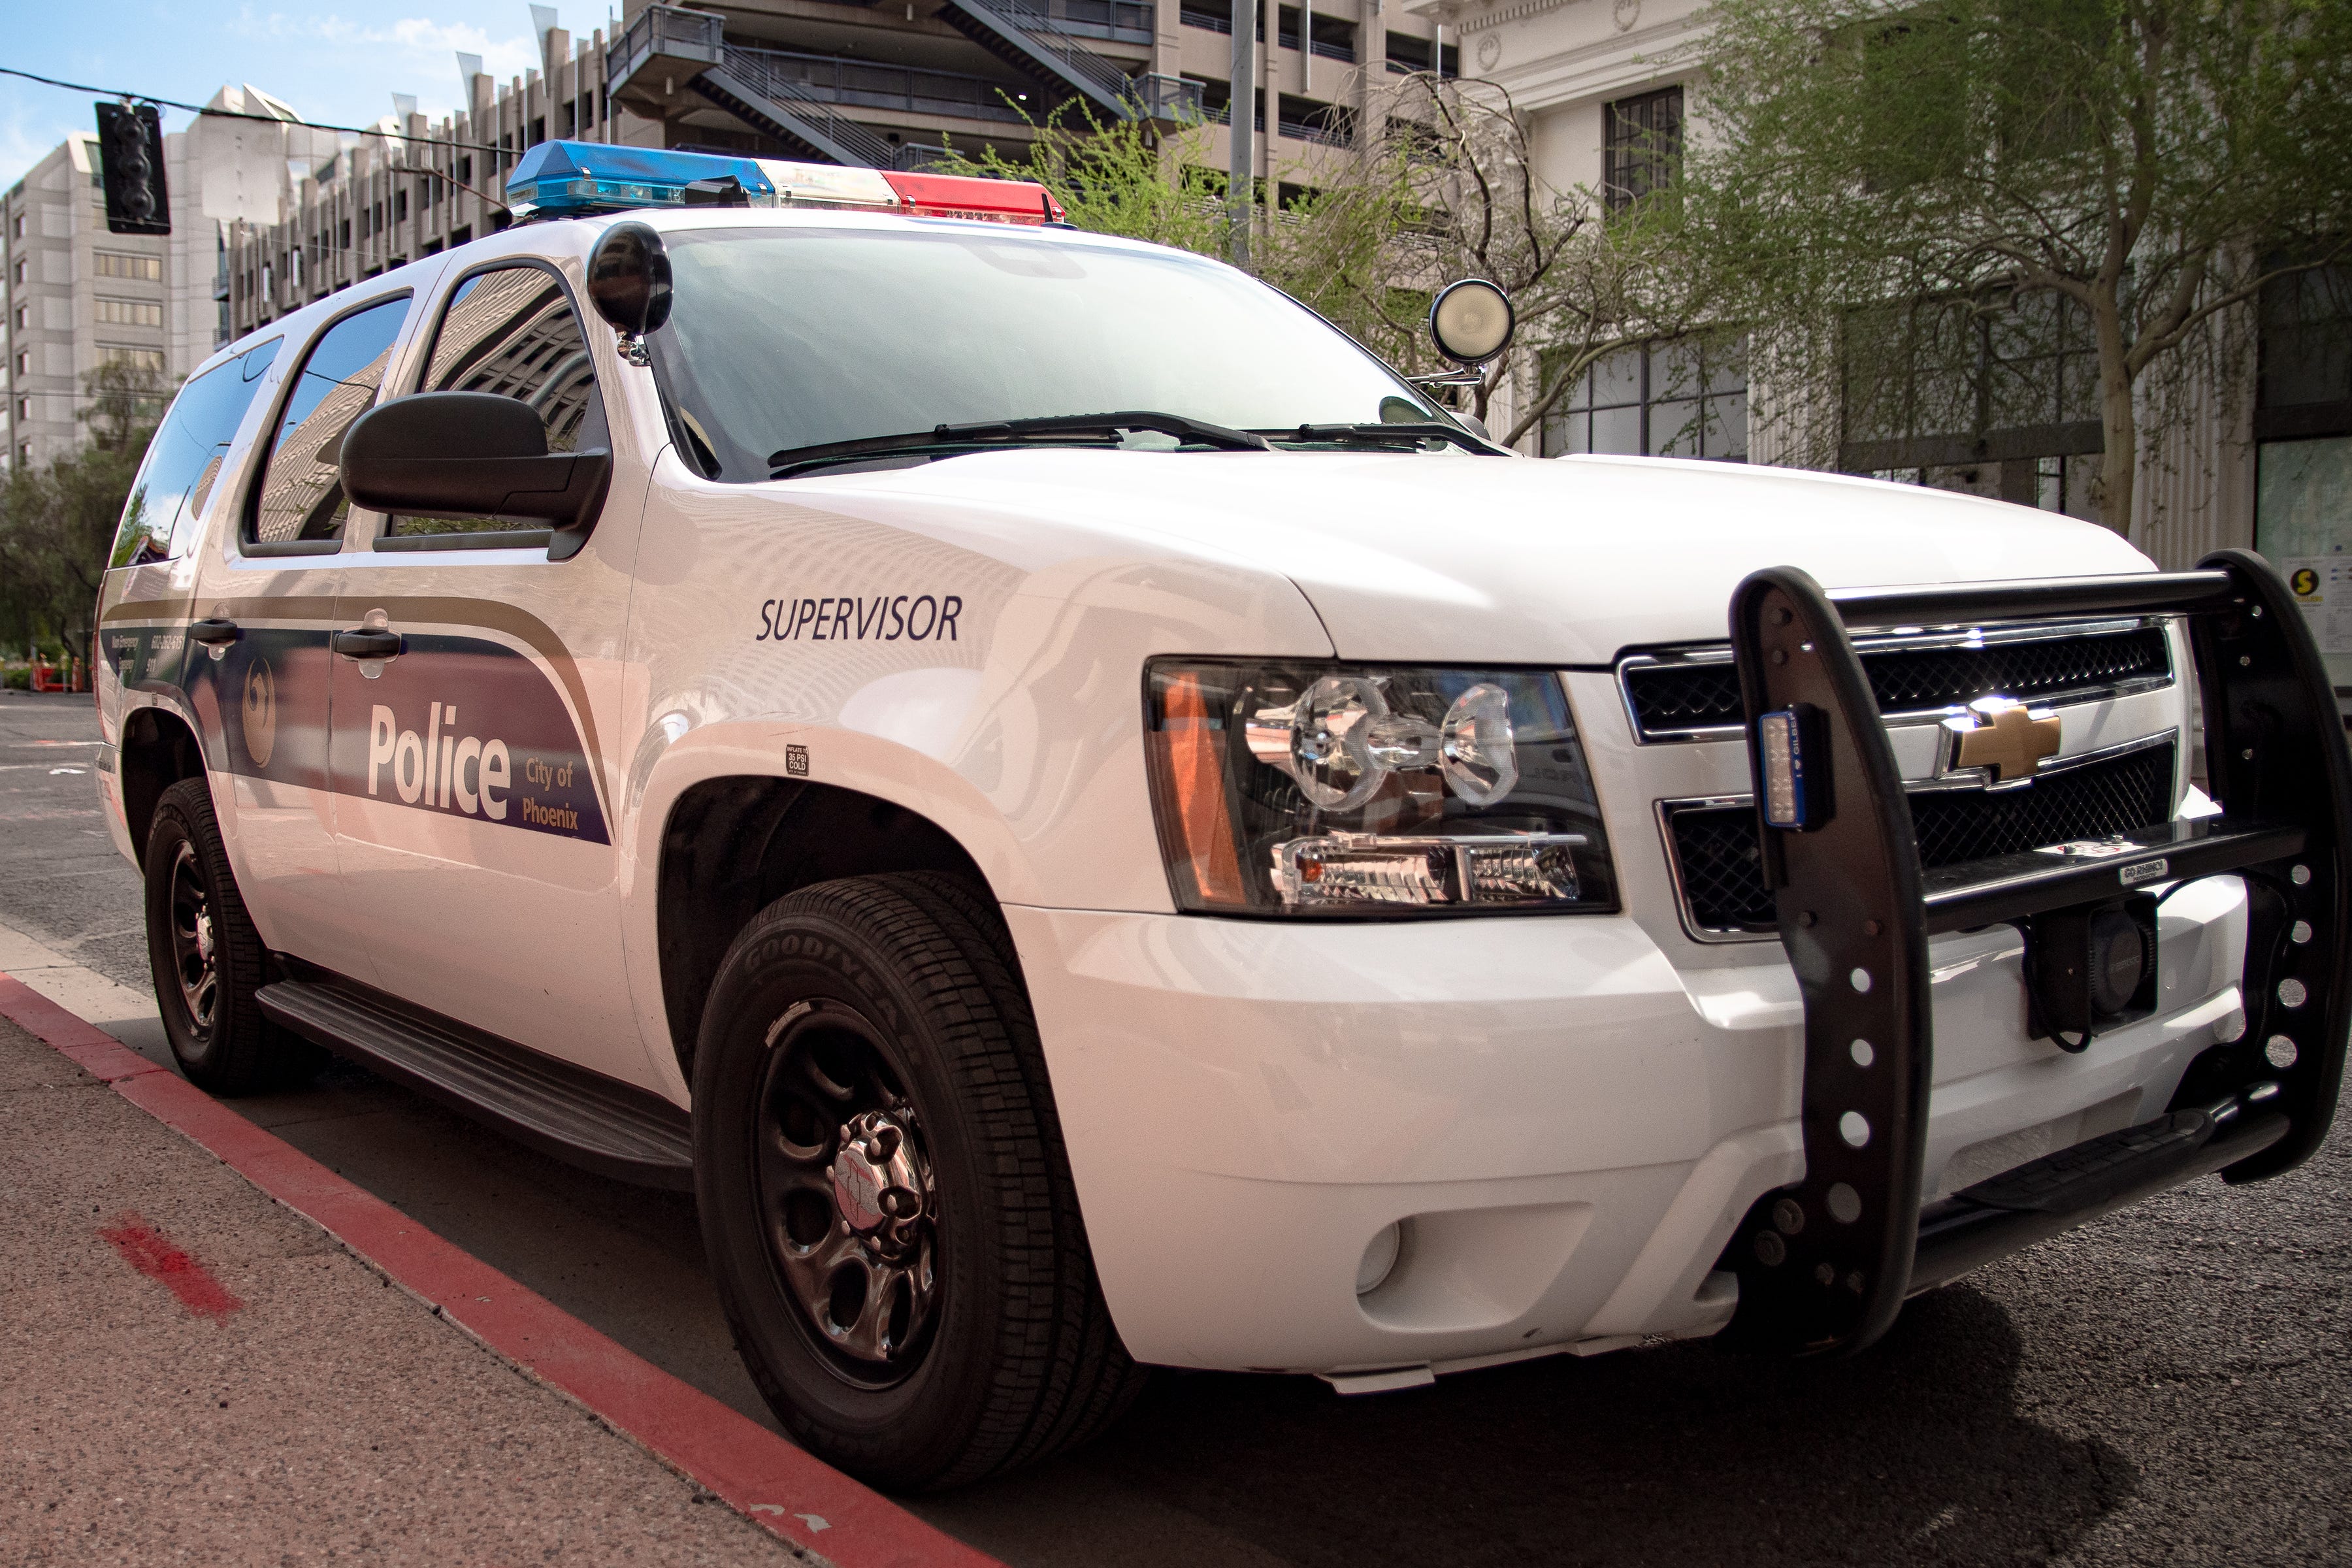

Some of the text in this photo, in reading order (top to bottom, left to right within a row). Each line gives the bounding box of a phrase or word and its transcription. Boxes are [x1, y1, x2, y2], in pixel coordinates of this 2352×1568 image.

[755, 595, 964, 642] SUPERVISOR
[368, 702, 511, 820] Police
[526, 757, 573, 792] City of
[789, 753, 807, 762] 35 PSI
[789, 761, 806, 770] COLD
[523, 797, 578, 830] Phoenix
[743, 934, 923, 1066] GOODYEAR
